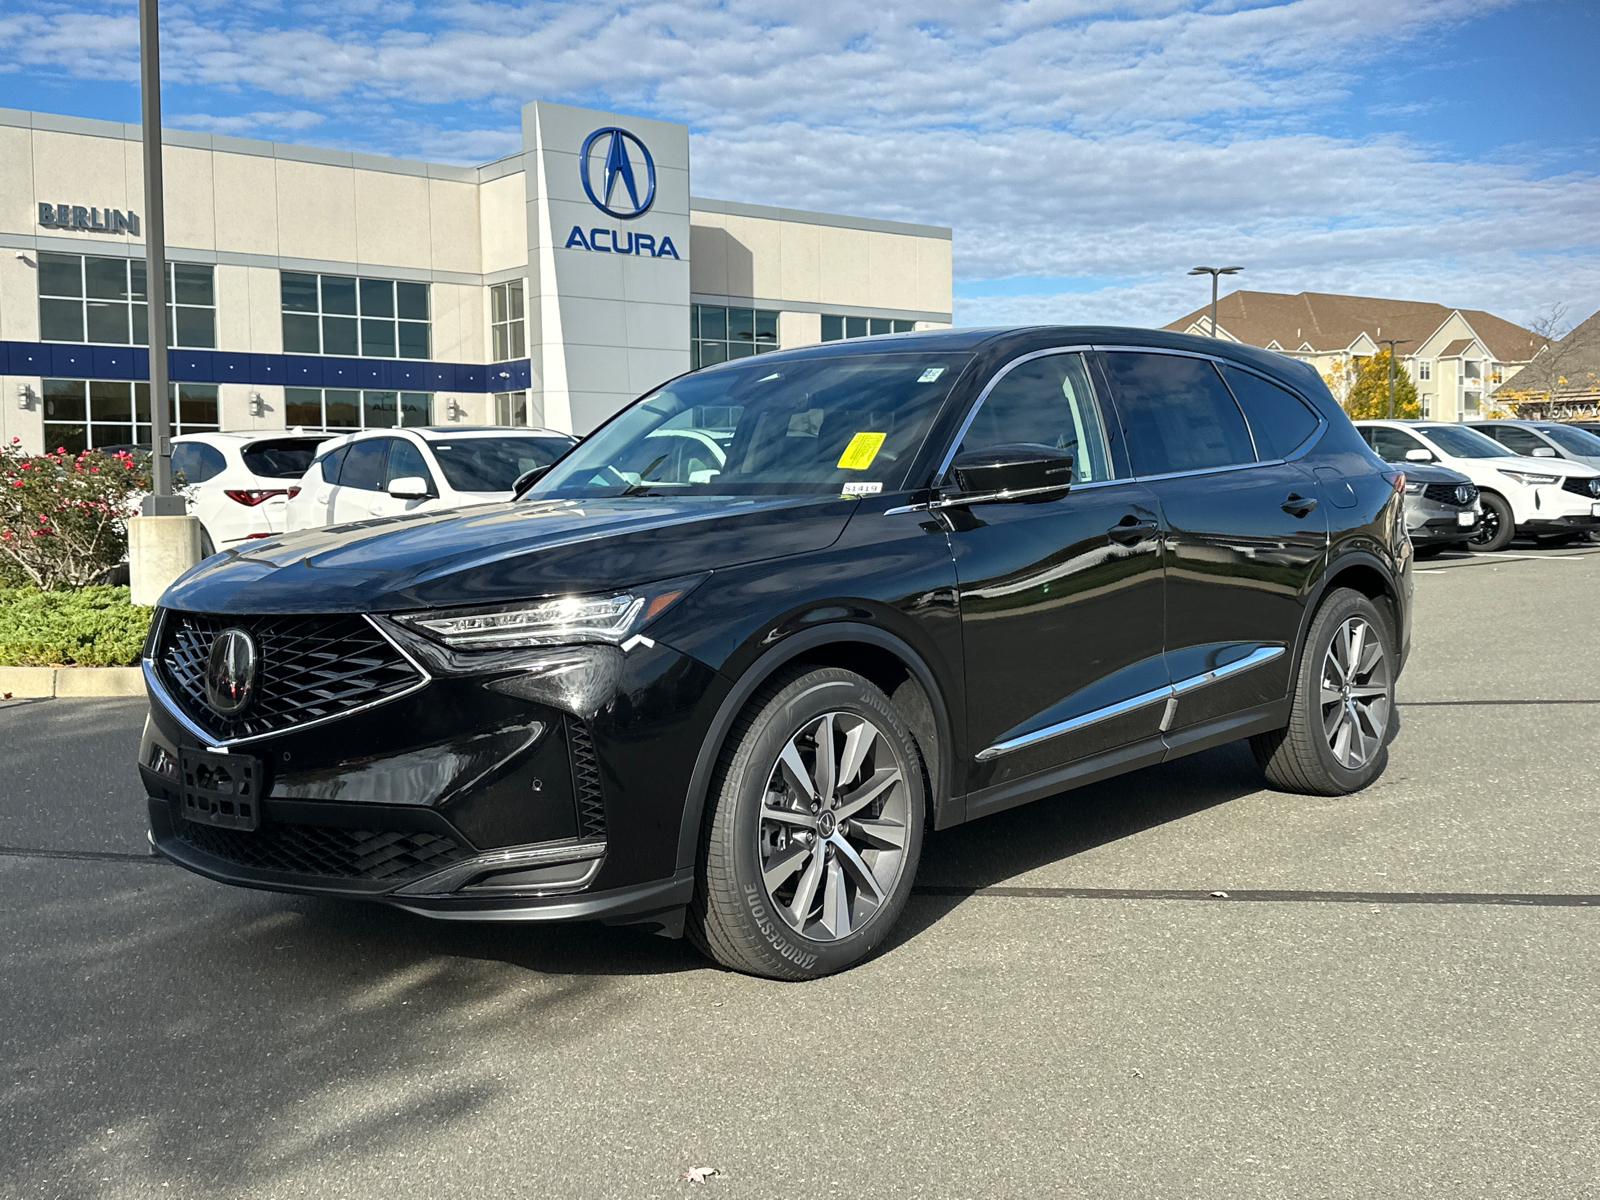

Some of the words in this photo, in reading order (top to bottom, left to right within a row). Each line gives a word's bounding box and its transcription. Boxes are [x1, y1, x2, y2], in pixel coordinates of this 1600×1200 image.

[38, 202, 134, 232] BERLIN
[565, 226, 680, 260] ACURA
[860, 687, 919, 775] BRIDGESTONE
[743, 882, 819, 970] BRIDGESTONE
